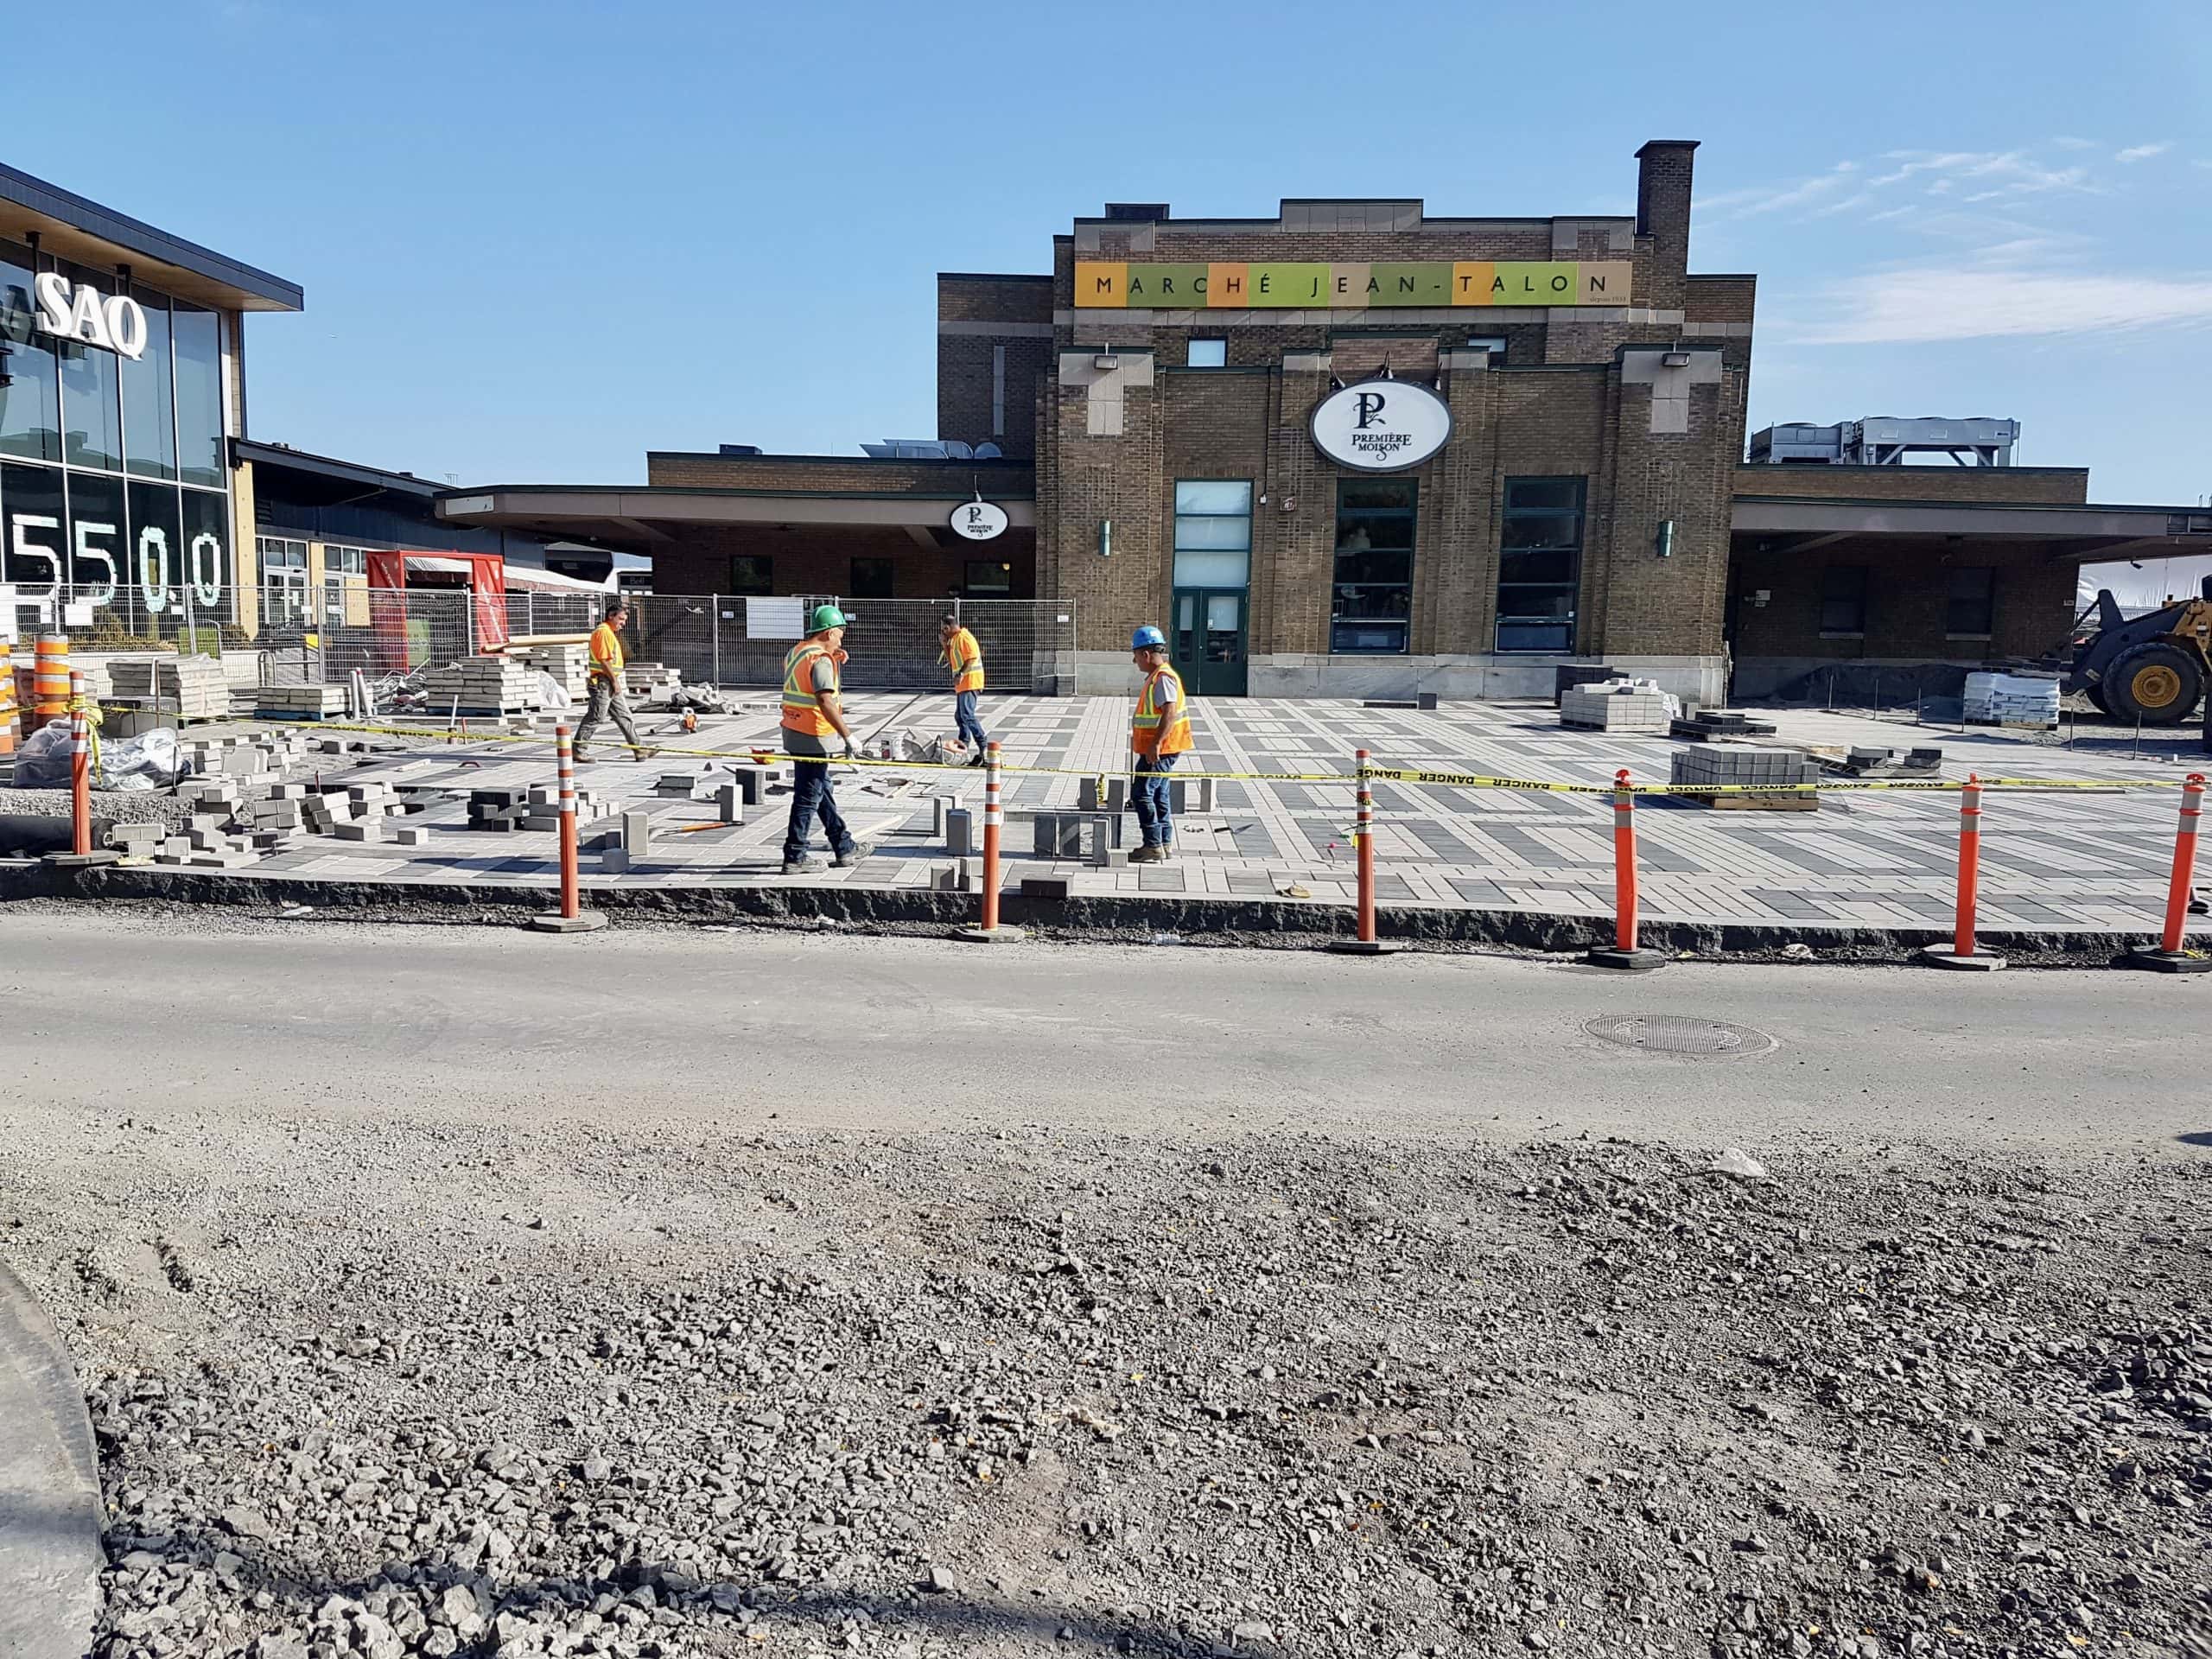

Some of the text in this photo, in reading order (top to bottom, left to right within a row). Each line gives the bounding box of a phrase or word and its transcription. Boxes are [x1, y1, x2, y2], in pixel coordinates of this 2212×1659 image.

[1096, 273, 1606, 298] MARCHÉ JEAN-TALON
[35, 272, 147, 361] SAQ
[1351, 432, 1412, 446] PREMIÈRE
[1357, 442, 1401, 461] MOISON
[1356, 768, 1401, 779] DANGE
[1419, 772, 1474, 785] DANGER
[1492, 778, 1550, 790] DANGER
